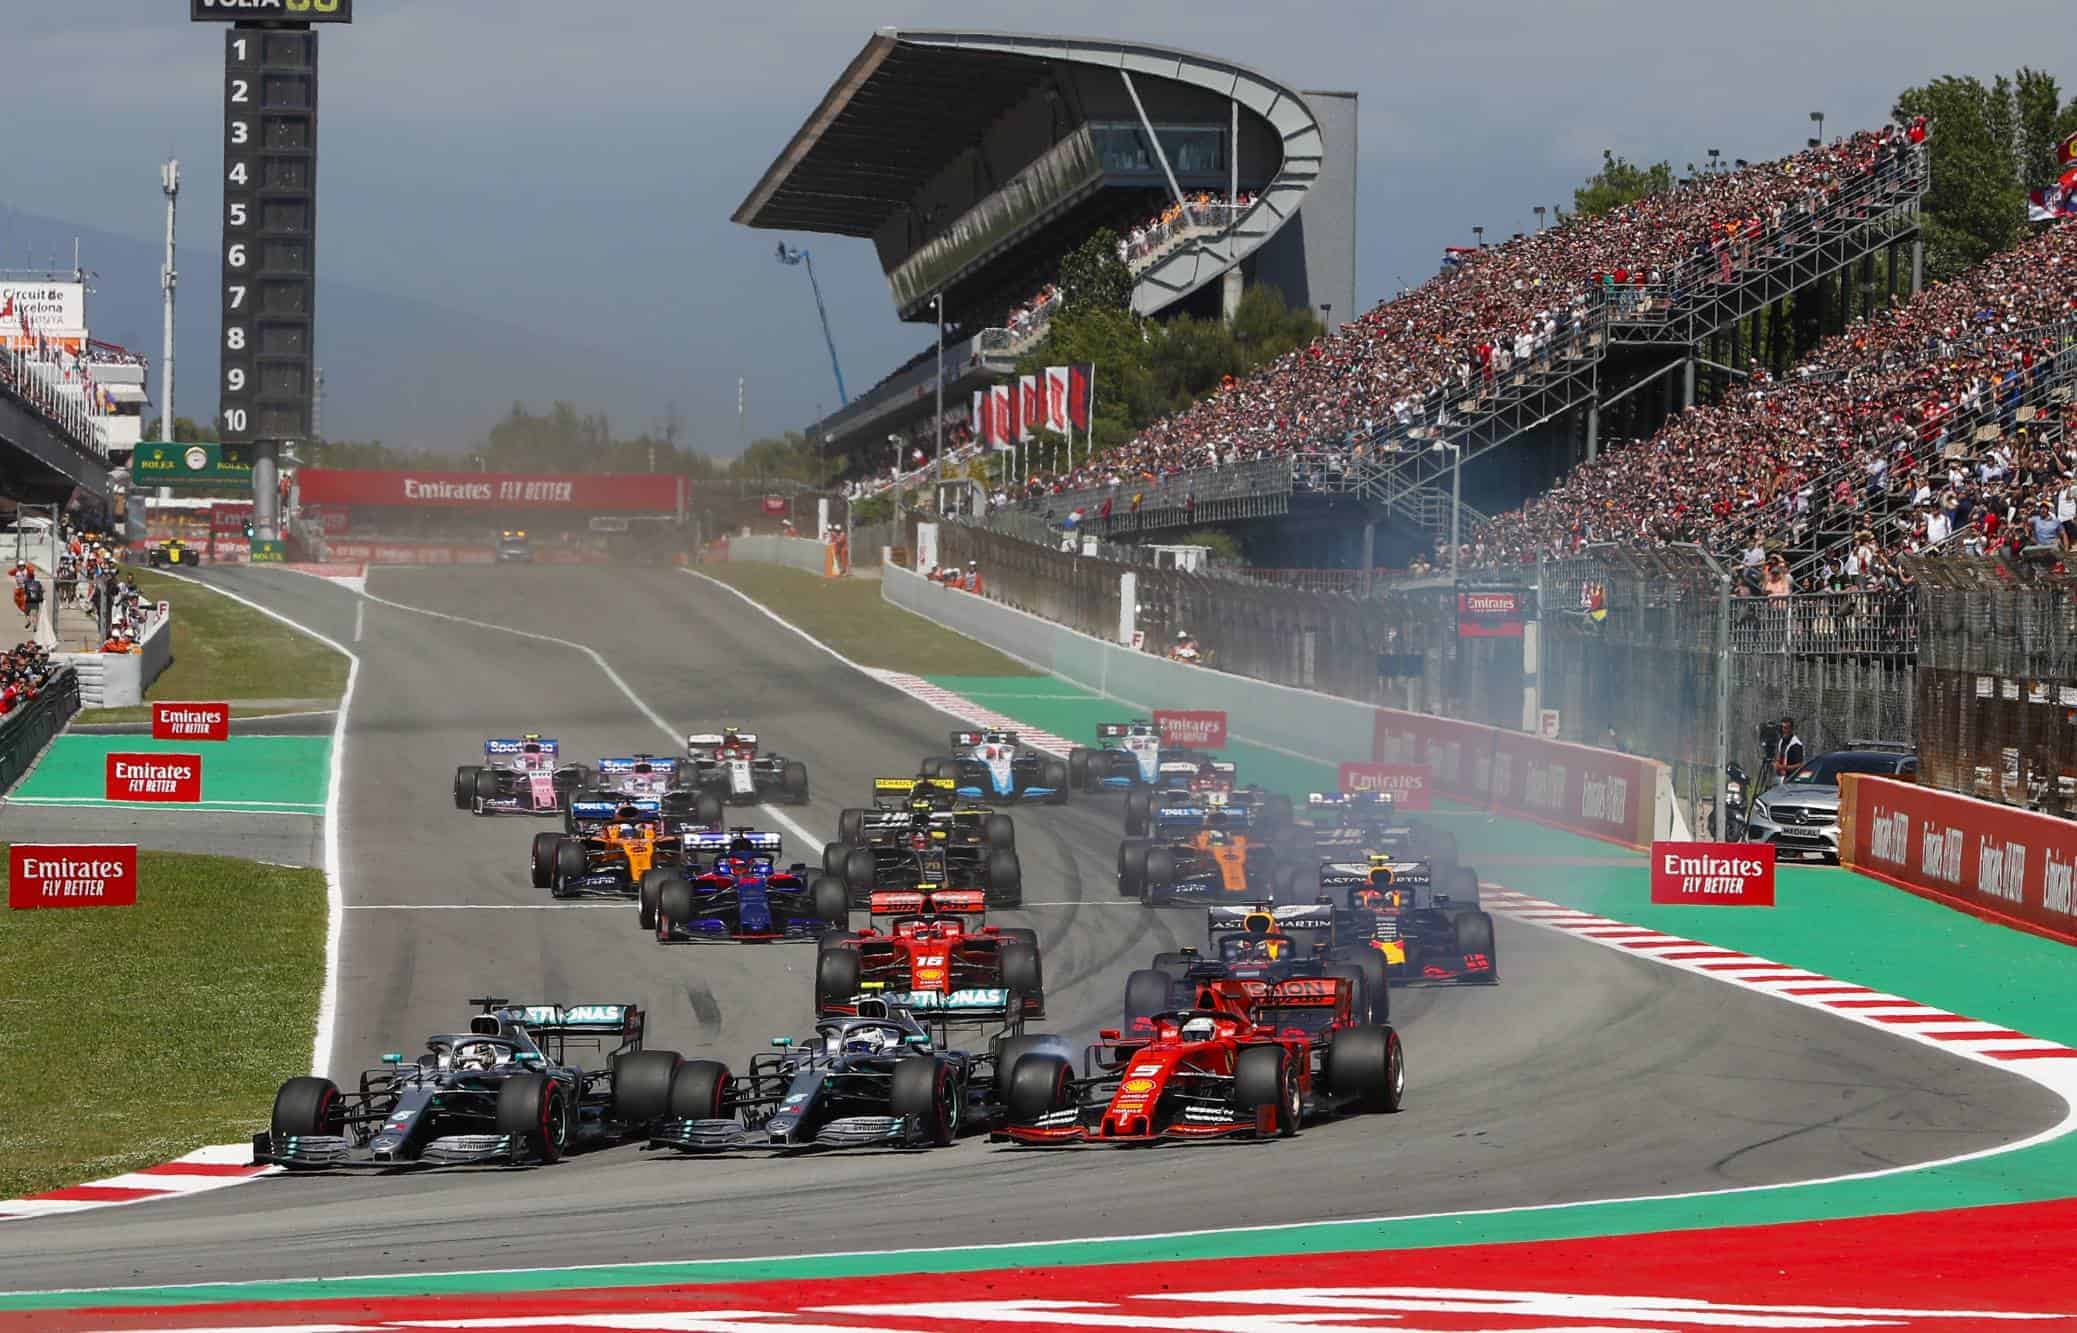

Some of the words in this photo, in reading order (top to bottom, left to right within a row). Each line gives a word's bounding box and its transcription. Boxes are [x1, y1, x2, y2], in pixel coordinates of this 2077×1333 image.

[232, 39, 247, 60] 1
[231, 80, 248, 102] 2
[231, 121, 248, 144] 3
[229, 162, 248, 185] 4
[229, 203, 247, 226] 5
[228, 244, 246, 267] 6
[3, 288, 46, 300] Crcuit
[229, 286, 246, 308] 7
[228, 327, 245, 350] 8
[228, 368, 245, 391] 9
[224, 409, 247, 432] 10
[404, 479, 492, 500] Emirates
[160, 709, 221, 724] Emirates
[115, 761, 192, 780] Emirates
[129, 780, 146, 793] FLY
[145, 780, 177, 793] BETTER
[23, 857, 124, 878] Emirates
[1664, 853, 1763, 877] Emirates
[42, 880, 61, 897] FLY
[64, 880, 105, 897] BETTER
[1682, 877, 1703, 893] FLY
[1703, 877, 1744, 894] BETTER
[916, 956, 944, 967] 16
[1130, 1064, 1163, 1078] 5
